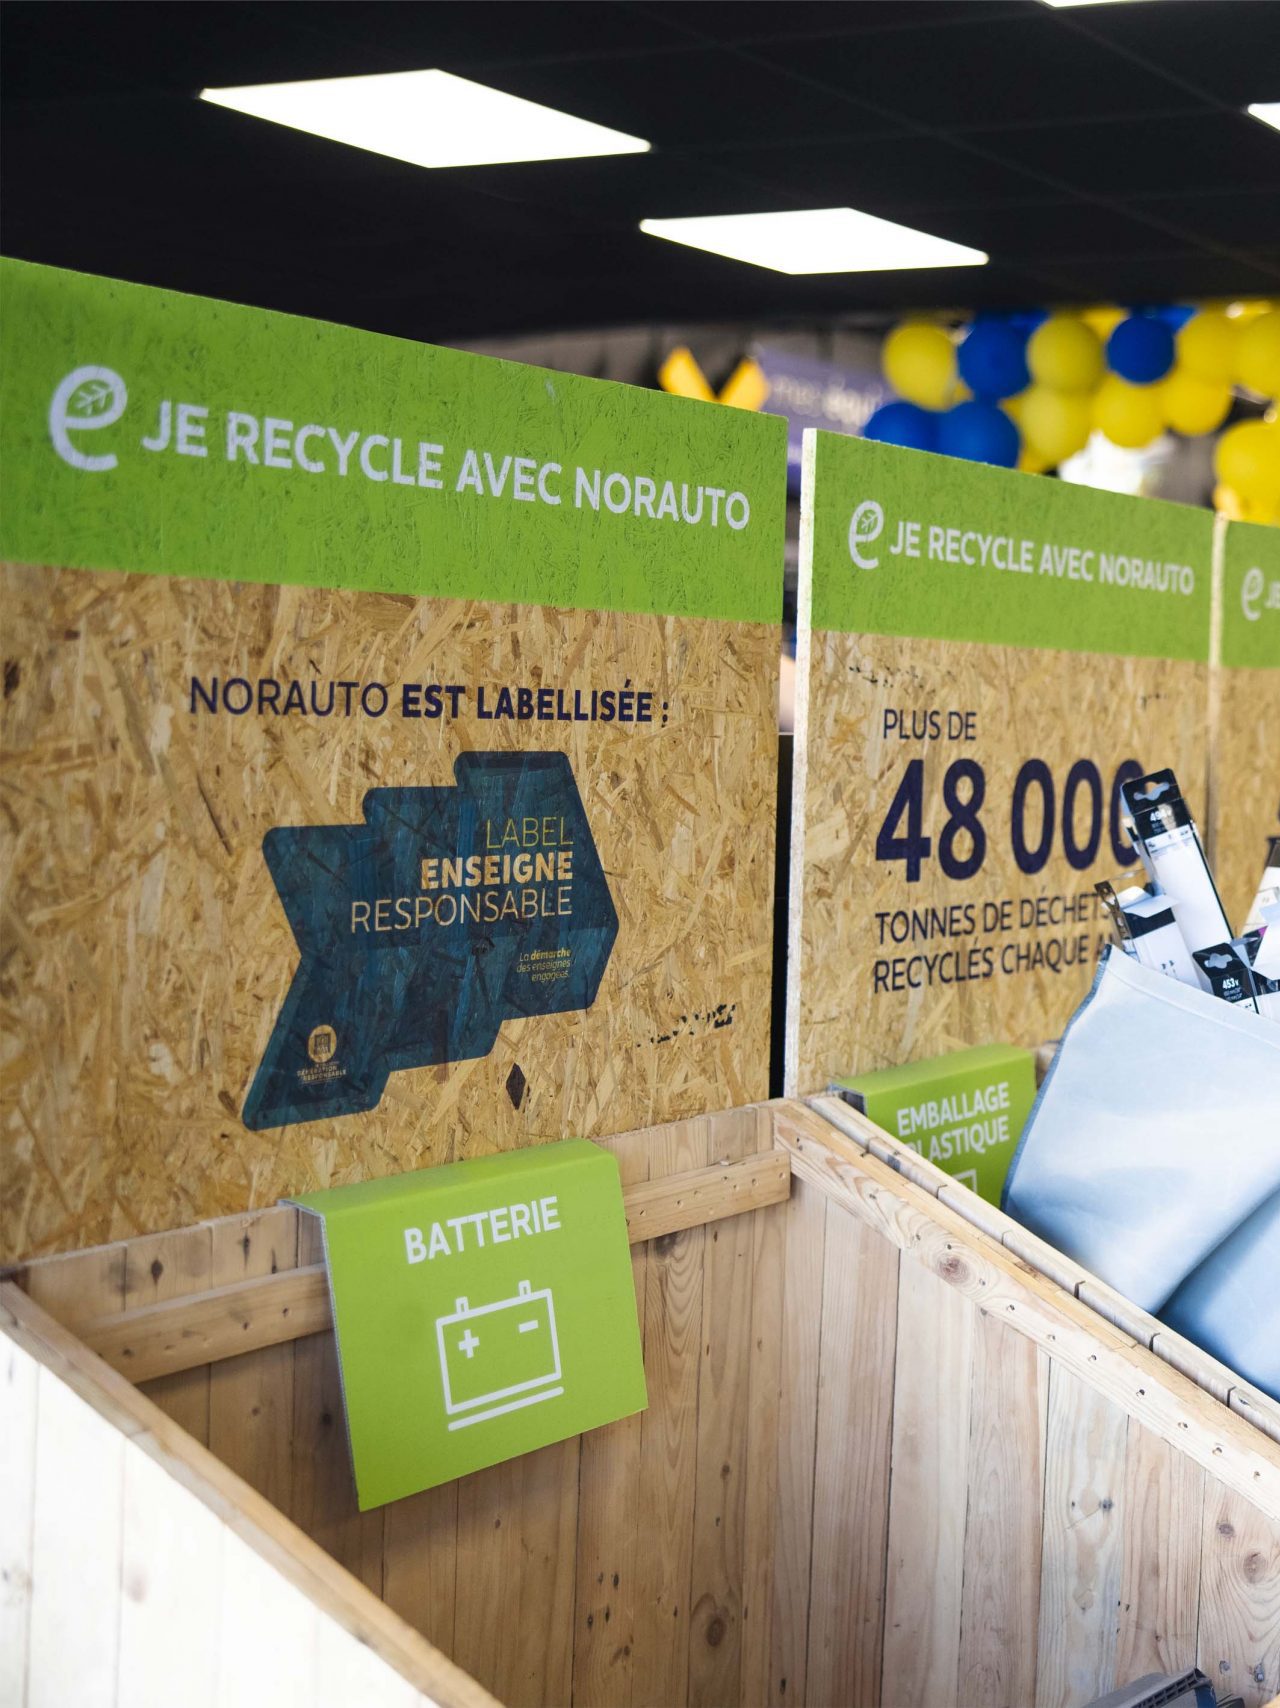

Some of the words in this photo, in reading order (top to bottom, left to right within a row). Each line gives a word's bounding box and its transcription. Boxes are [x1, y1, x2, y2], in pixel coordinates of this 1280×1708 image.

[142, 400, 209, 458] JE
[226, 412, 445, 490] RECYCLE
[456, 448, 562, 506] AVEC
[574, 468, 750, 530] NORAUTO
[889, 520, 921, 557] JE
[928, 525, 1034, 572] RECYCLE
[1039, 543, 1093, 582] AVEC
[1099, 553, 1195, 595] NORAUTO
[189, 677, 389, 718] NORAUTO
[401, 684, 466, 720] EST
[477, 679, 653, 723] LABELLISÉE
[883, 708, 942, 741] PLUS
[947, 710, 978, 742] DE
[486, 816, 574, 849] LABEL
[875, 757, 988, 883] 48
[1011, 757, 1145, 876] 000
[420, 851, 573, 890] ENSEIGNE
[351, 886, 572, 934] RESPONSABLE
[875, 902, 976, 945] TONNES
[983, 900, 1012, 933] DE
[520, 952, 529, 962] La
[530, 946, 571, 961] démarche
[532, 958, 571, 971] enseignes
[874, 936, 993, 994] RECYCLÉS
[1001, 942, 1089, 975] CHAQUE
[897, 1081, 1010, 1136] EMBALLAGE
[404, 1196, 562, 1264] BATTERIE
